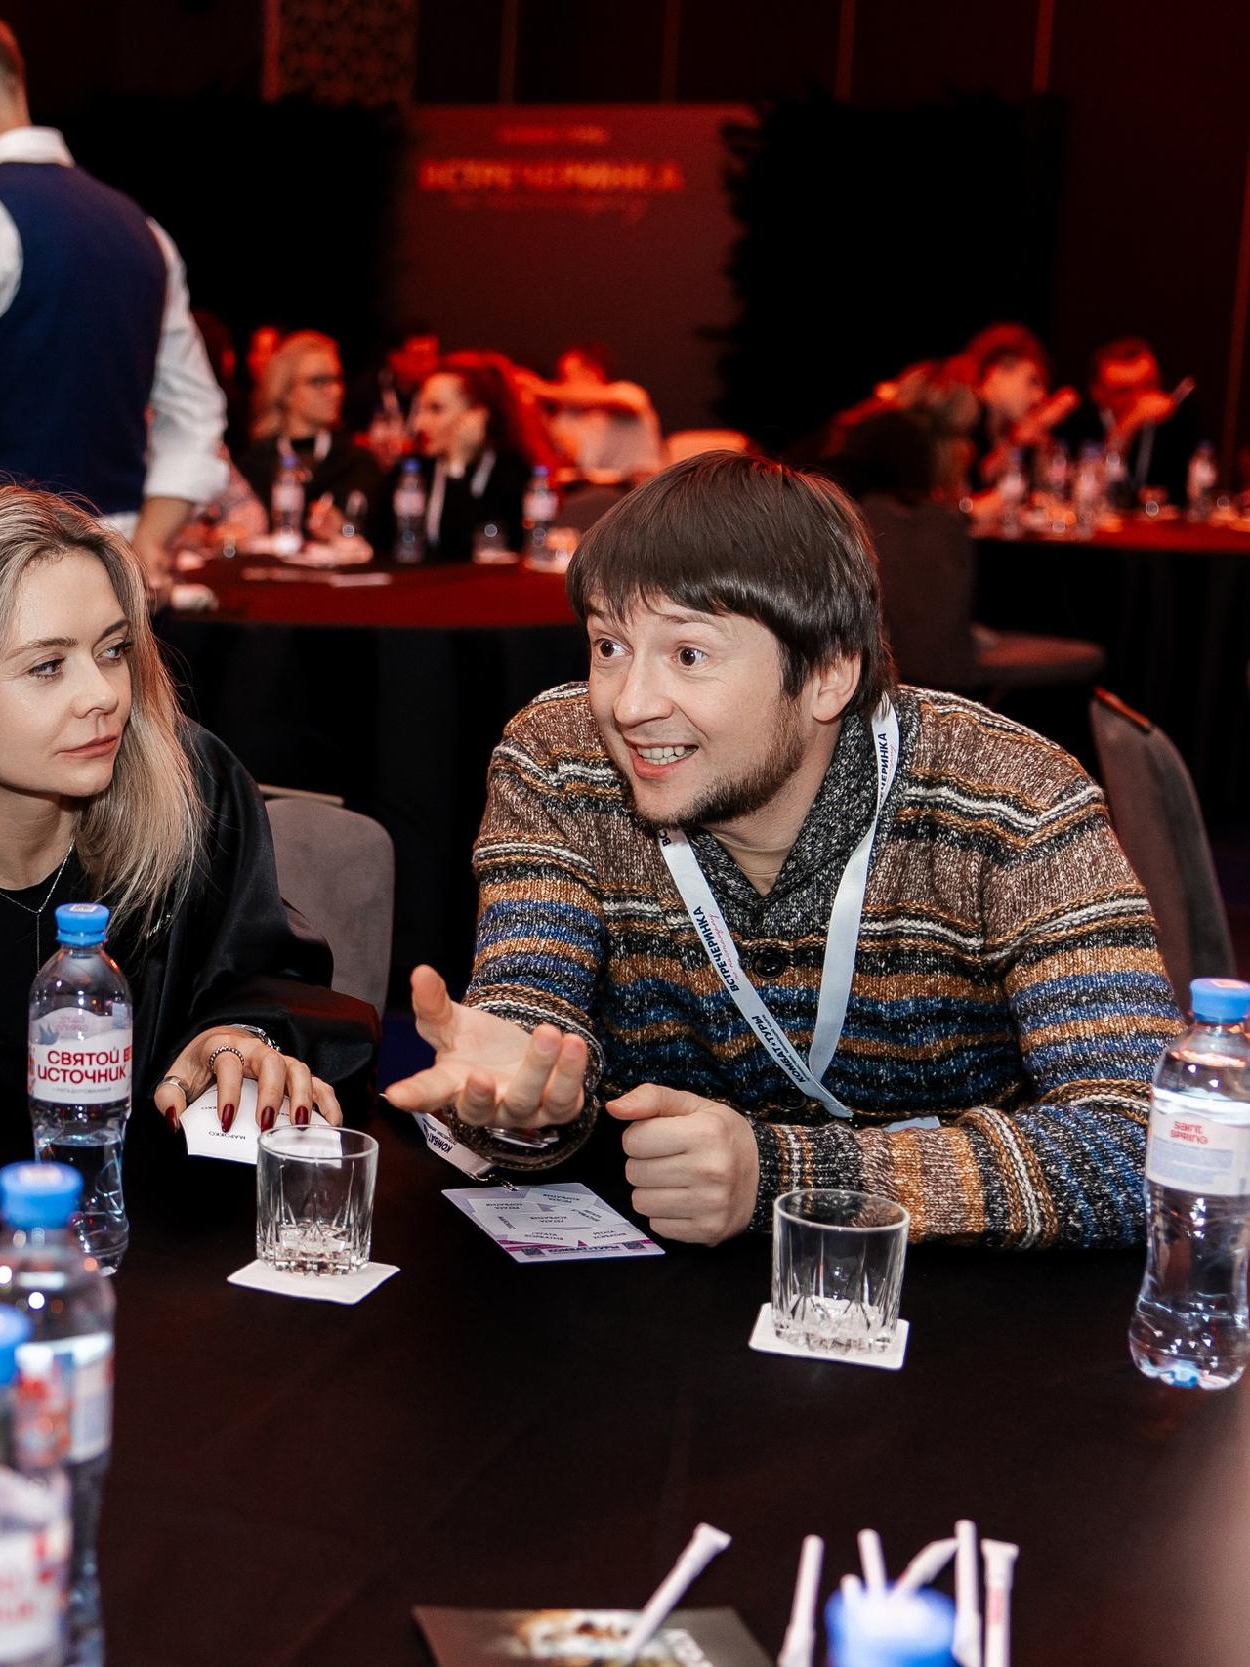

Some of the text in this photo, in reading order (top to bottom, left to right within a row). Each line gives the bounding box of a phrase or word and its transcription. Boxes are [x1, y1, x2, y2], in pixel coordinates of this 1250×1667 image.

[692, 906, 740, 992] ВСТРЕЧЕРИНКА
[47, 1046, 120, 1066] СВЯТОЙ
[37, 1064, 127, 1084] ИСТОЧНИК
